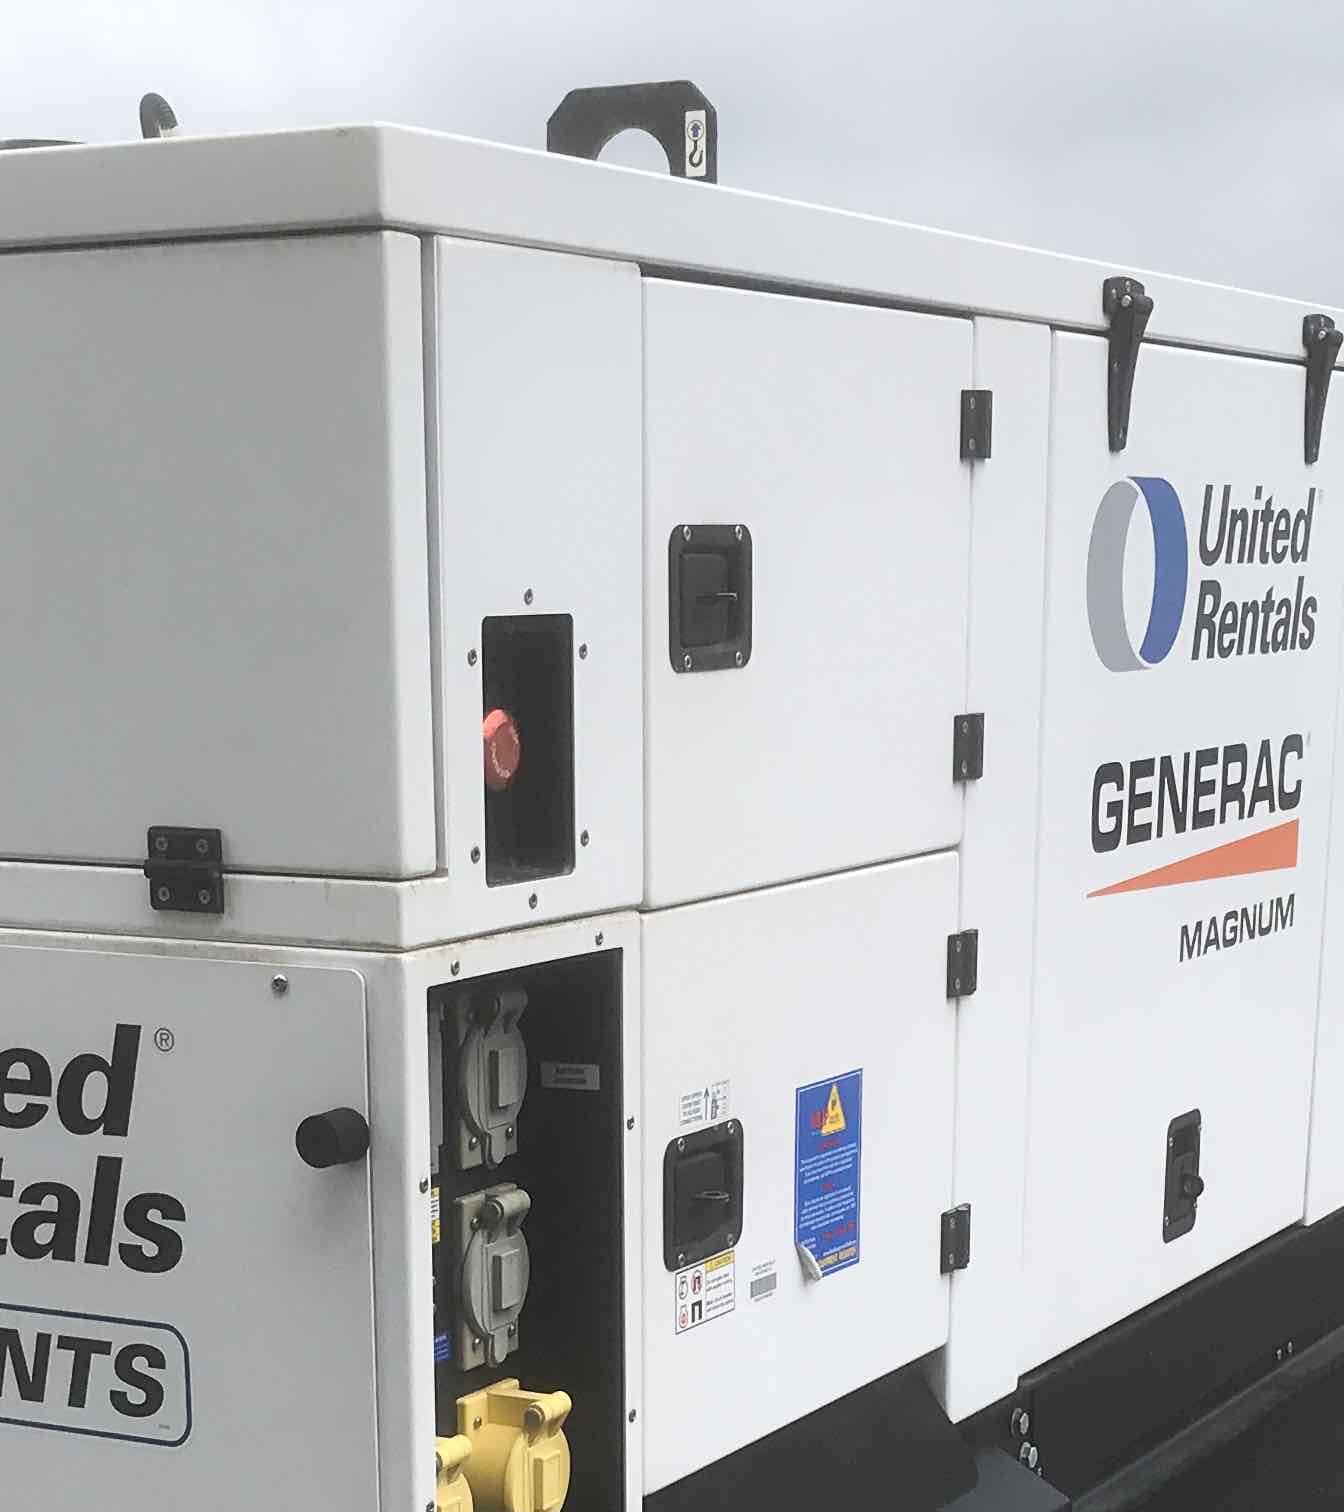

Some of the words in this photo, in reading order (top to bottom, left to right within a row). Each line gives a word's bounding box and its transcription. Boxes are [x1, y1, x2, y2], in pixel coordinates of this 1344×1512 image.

[1198, 484, 1316, 566] United
[1191, 575, 1318, 661] Rentals
[1090, 733, 1303, 853] GENERAC
[1178, 893, 1295, 963] MAGNUM
